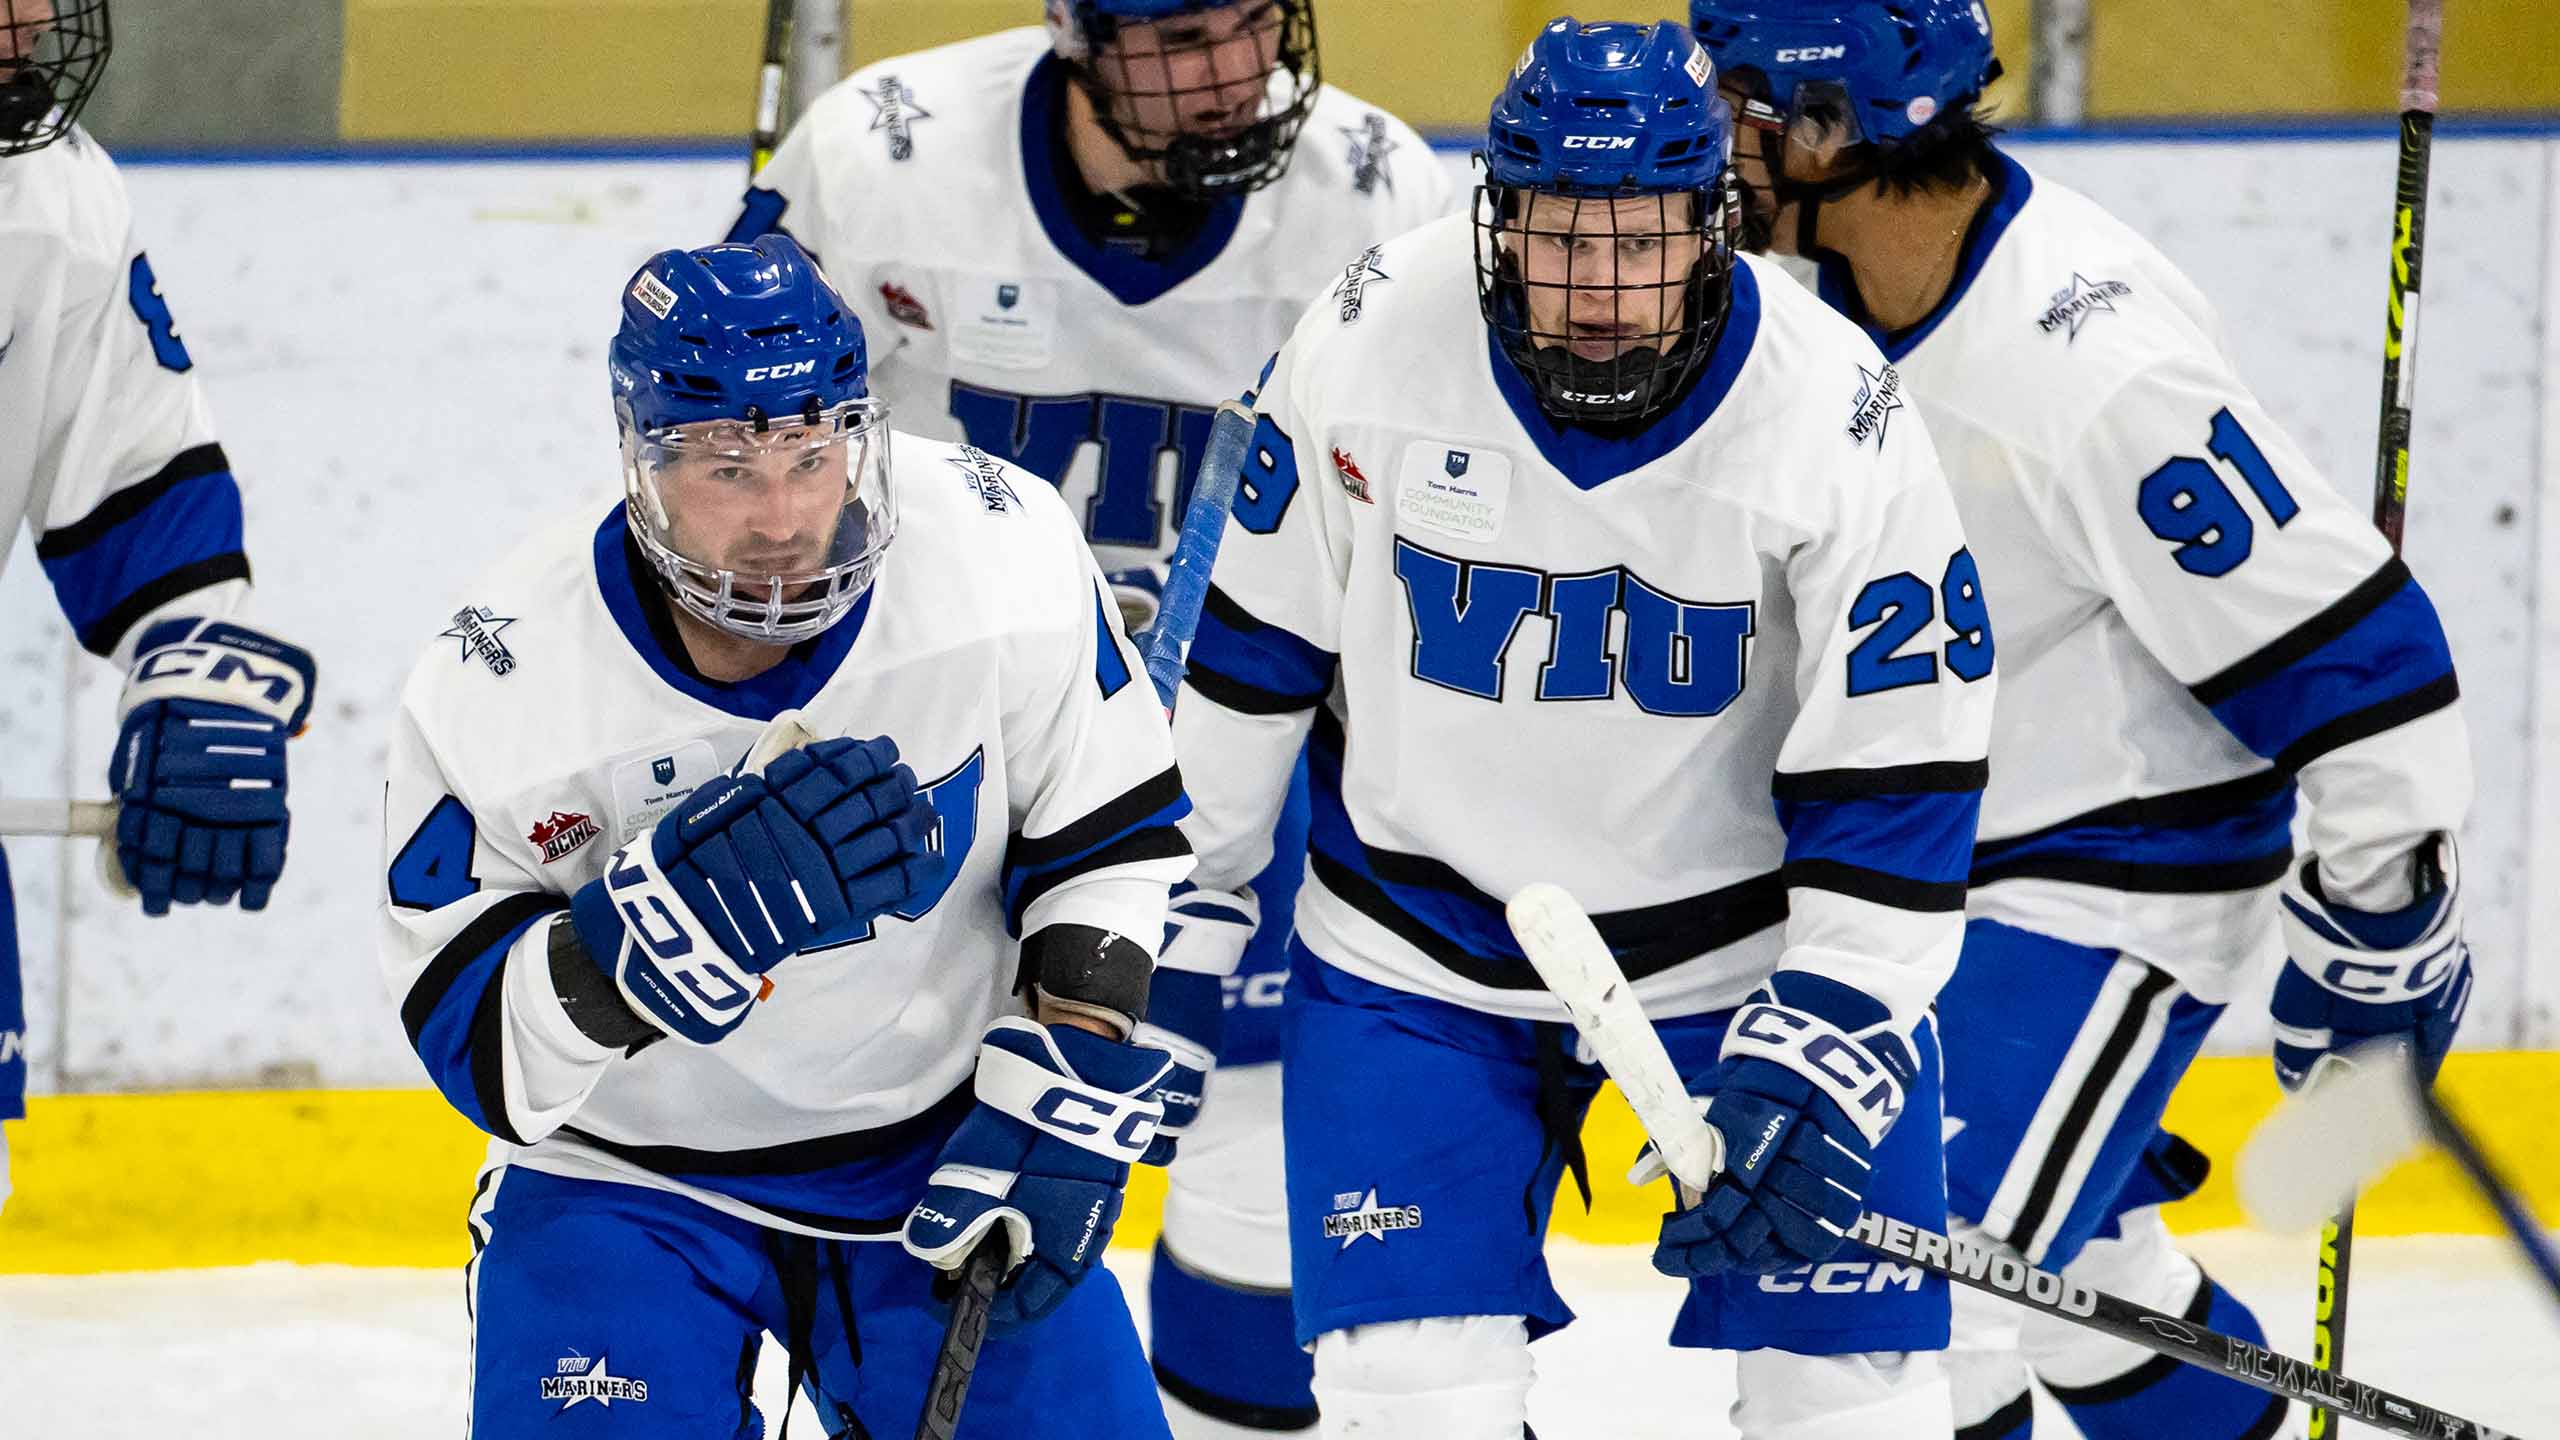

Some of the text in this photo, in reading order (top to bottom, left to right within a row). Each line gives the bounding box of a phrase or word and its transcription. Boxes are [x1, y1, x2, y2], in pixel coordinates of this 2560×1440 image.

[1775, 45, 1845, 63] CCM
[1562, 135, 1636, 149] CCM
[745, 359, 816, 382] CCM
[1561, 390, 1636, 404] CCM
[1848, 364, 1899, 442] MARINERS
[1231, 350, 1300, 534] 9
[1452, 454, 1466, 464] TH
[1406, 487, 1495, 515] COMMUNITY
[1427, 480, 1478, 497] Tom Harris
[2138, 406, 2300, 578] 91
[1400, 498, 1495, 531] FOUNDATION
[1394, 533, 1756, 717] VIU
[1847, 543, 1995, 698] 29
[454, 605, 514, 676] MARINERS
[136, 647, 293, 705] CM
[656, 761, 670, 771] TH
[644, 796, 664, 806] Tom
[385, 781, 481, 912] 4
[544, 817, 593, 859] BCIHL
[2322, 945, 2456, 995] CC
[1737, 1006, 1901, 1138] CCM
[1031, 1087, 1162, 1150] CC
[915, 1206, 957, 1228] CCM
[1323, 1205, 1422, 1238] MARINERS
[1758, 1262, 1926, 1293] CCM
[1845, 1210, 2097, 1318] HERWOOD
[557, 1357, 591, 1373] VIU
[541, 1377, 647, 1401] MARINERS
